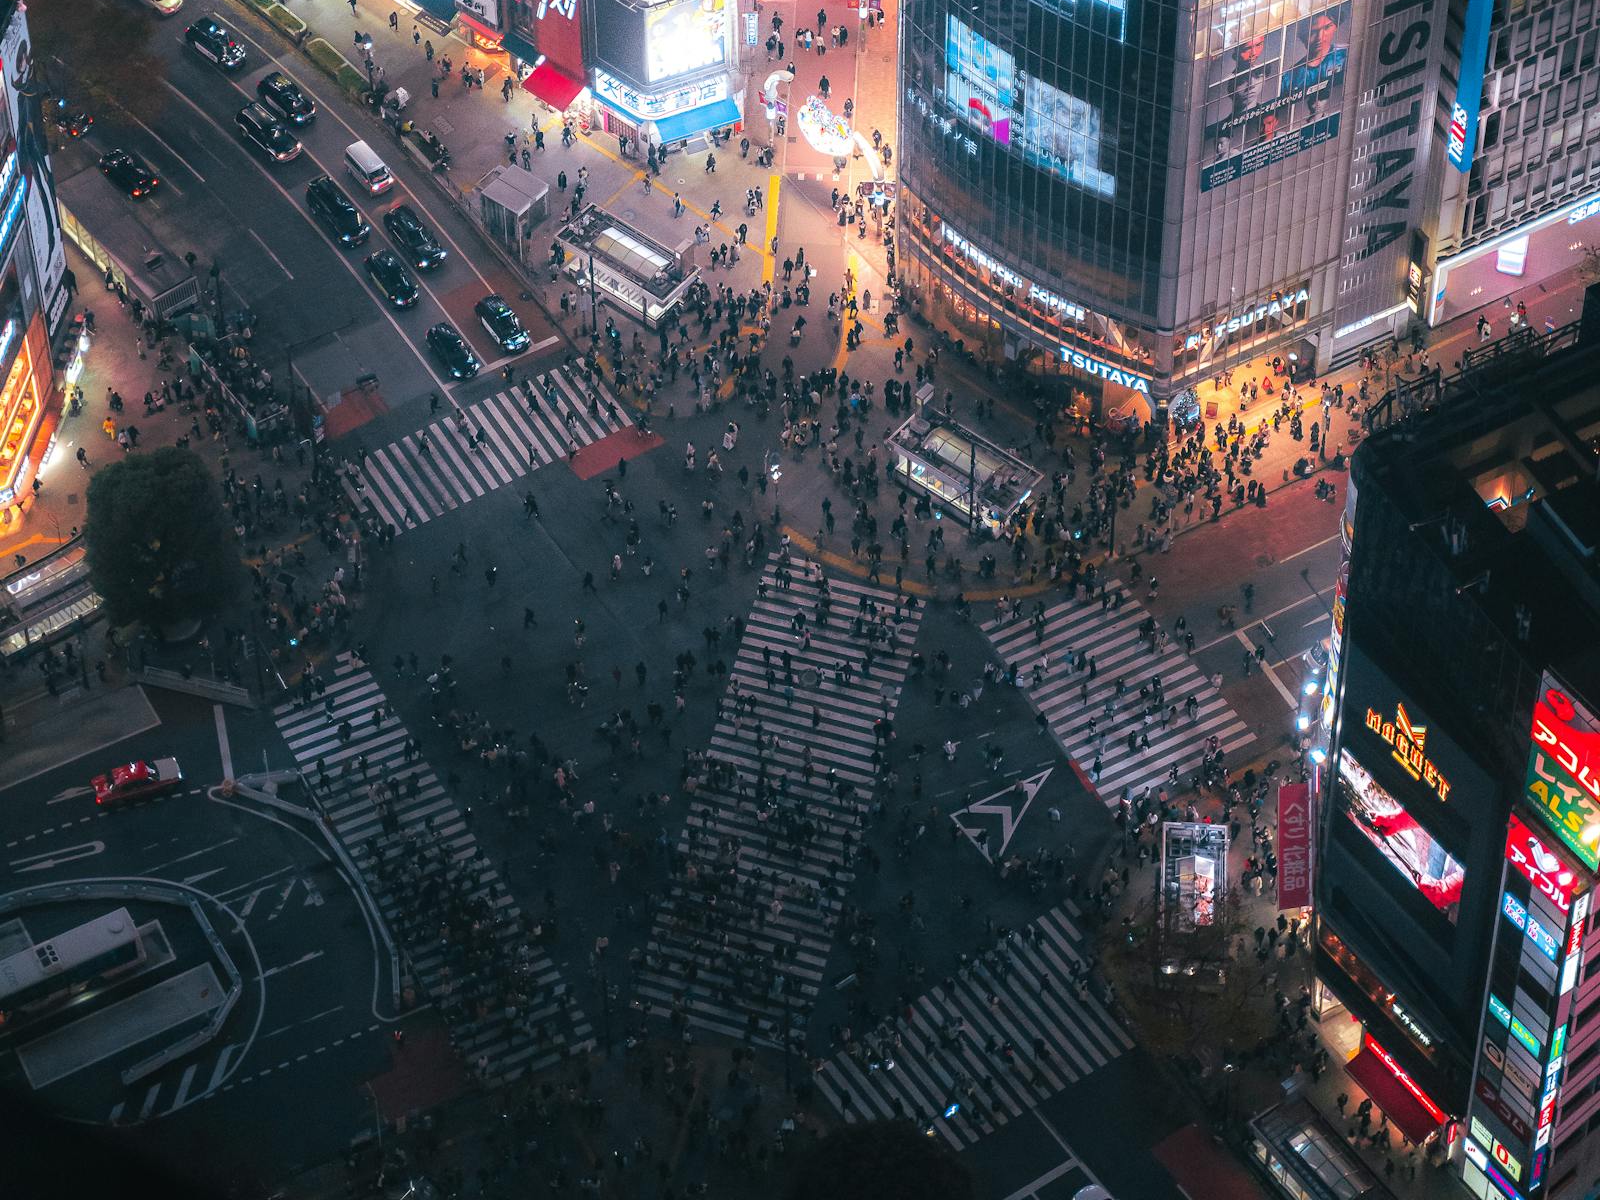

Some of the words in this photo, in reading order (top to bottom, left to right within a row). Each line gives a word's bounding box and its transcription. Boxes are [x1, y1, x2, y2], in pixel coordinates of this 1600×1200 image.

[1214, 289, 1311, 338] TSUTAYA
[1059, 346, 1150, 394] TSUTAYA
[1365, 706, 1452, 802] MAGNET
[1510, 844, 1570, 911] アイフル
